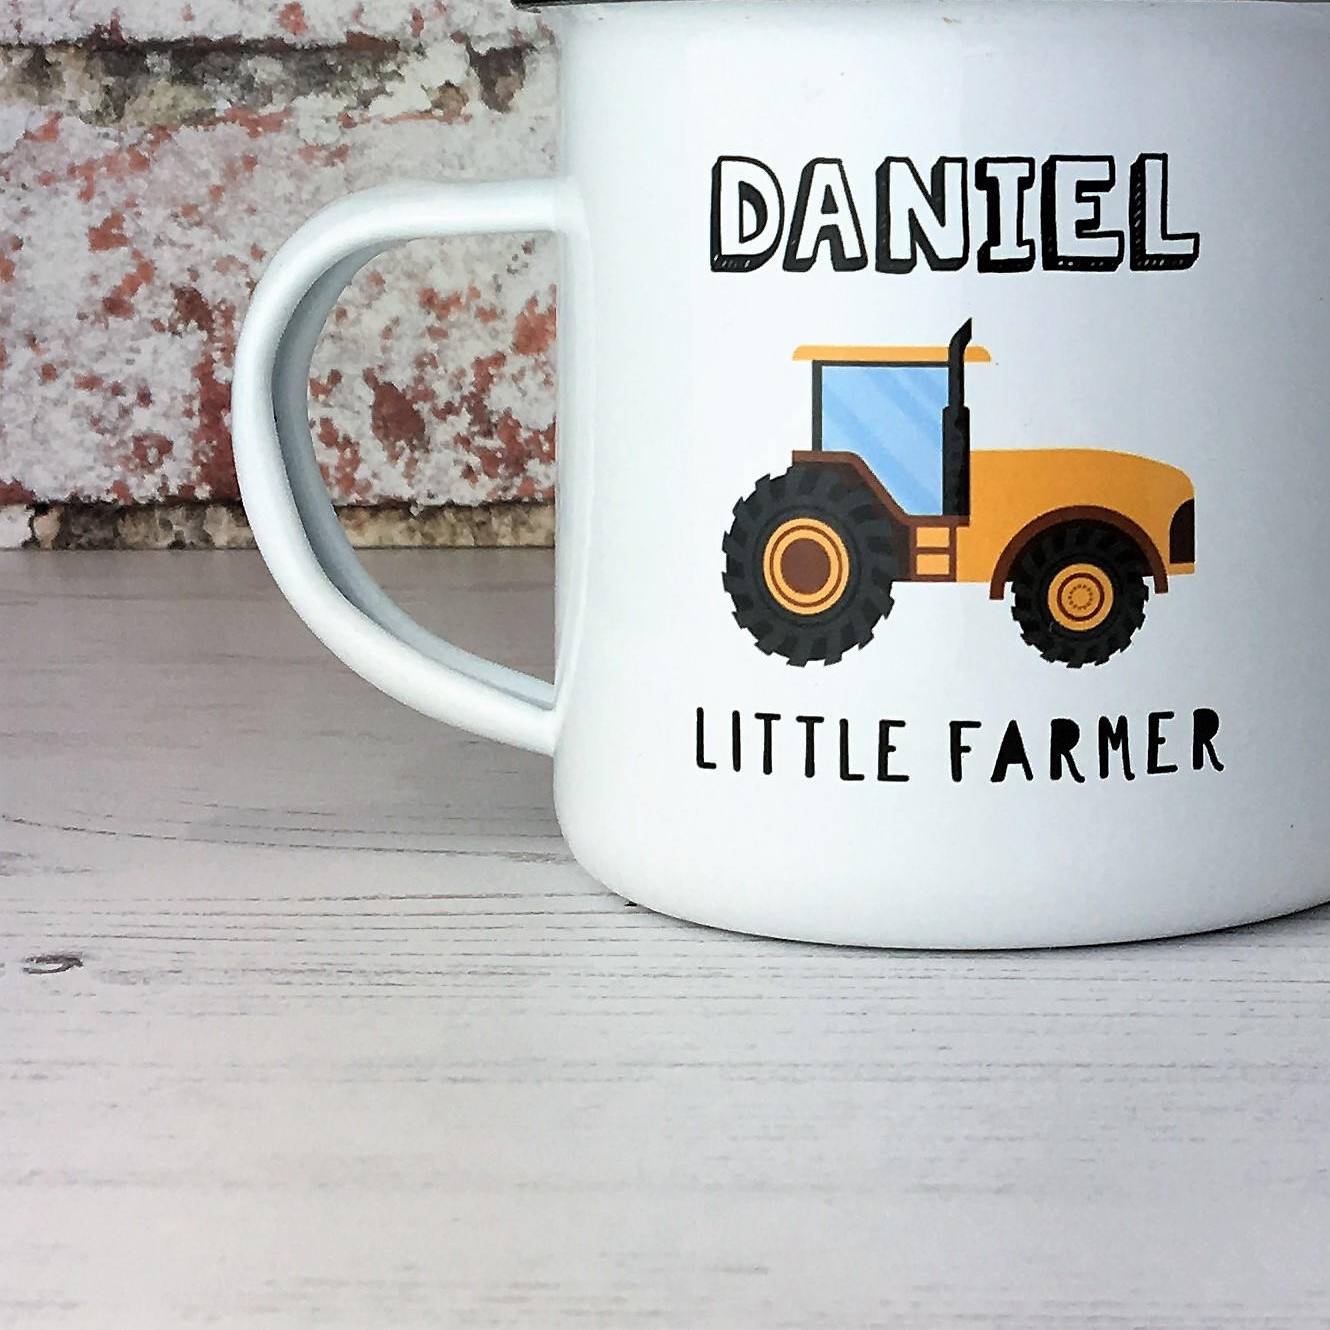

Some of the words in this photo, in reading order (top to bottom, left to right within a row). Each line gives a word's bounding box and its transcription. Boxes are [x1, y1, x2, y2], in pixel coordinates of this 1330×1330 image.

[709, 152, 1201, 275] DANIEL
[696, 706, 910, 783] LITTLE
[948, 707, 1225, 784] FARMER
